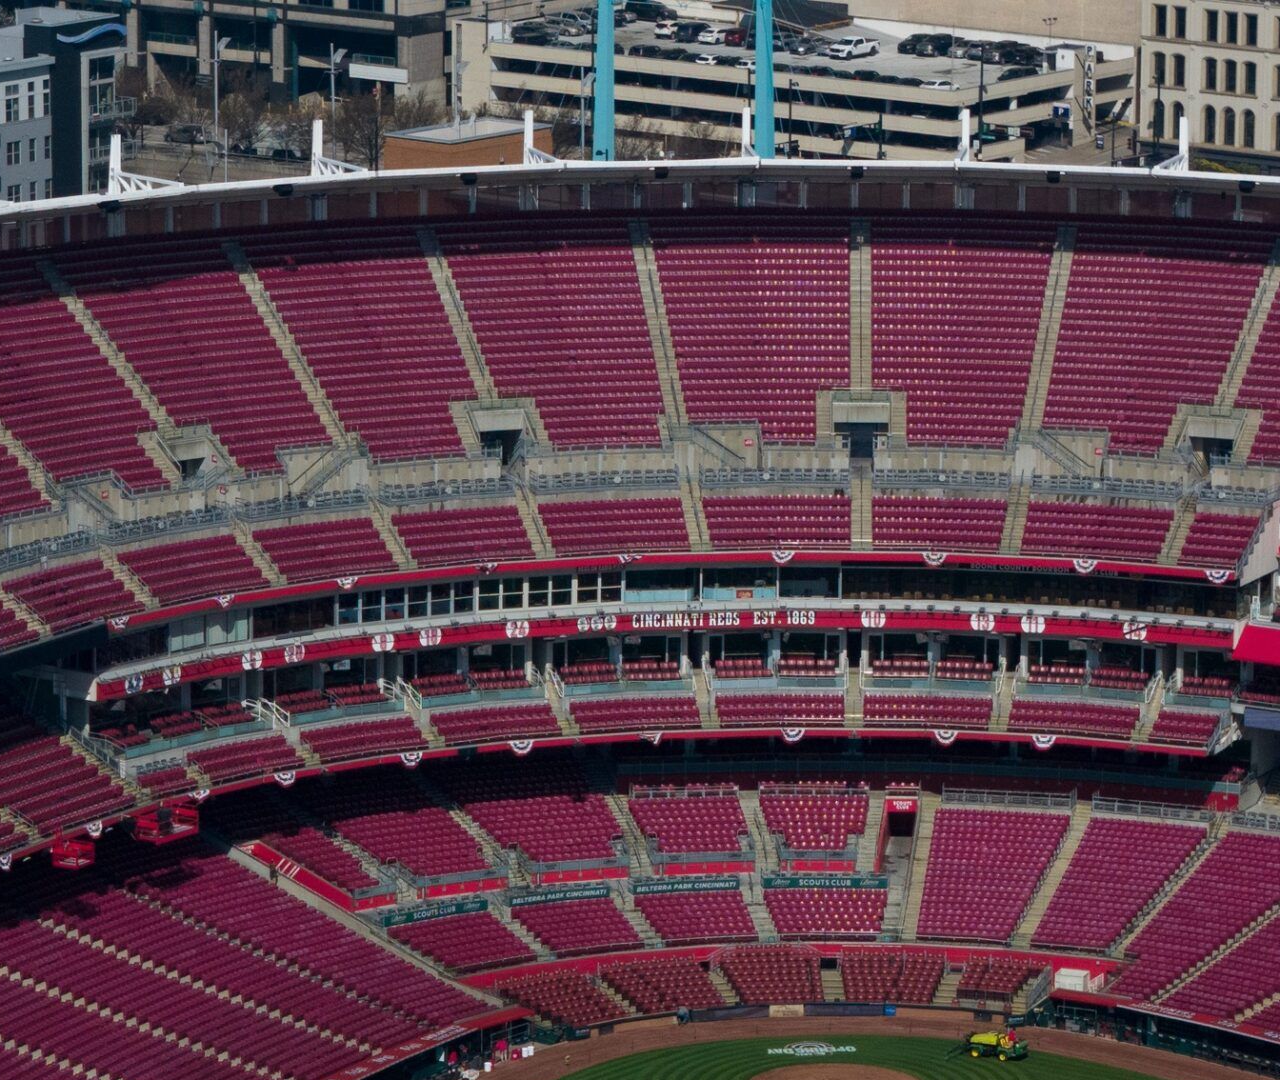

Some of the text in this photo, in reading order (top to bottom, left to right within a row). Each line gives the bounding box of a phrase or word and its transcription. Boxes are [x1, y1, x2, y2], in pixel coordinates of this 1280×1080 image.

[632, 610, 816, 629] CINCINNATI REDS EST. 1869
[637, 880, 737, 893] BELTERRA PARK CINCINNATI
[798, 879, 830, 887] SCOUTS
[831, 879, 852, 887] CLUB
[546, 892, 565, 902] PARK
[566, 889, 607, 899] CINCINNATI
[413, 907, 439, 920] SCOUTS
[439, 905, 456, 917] CLUB
